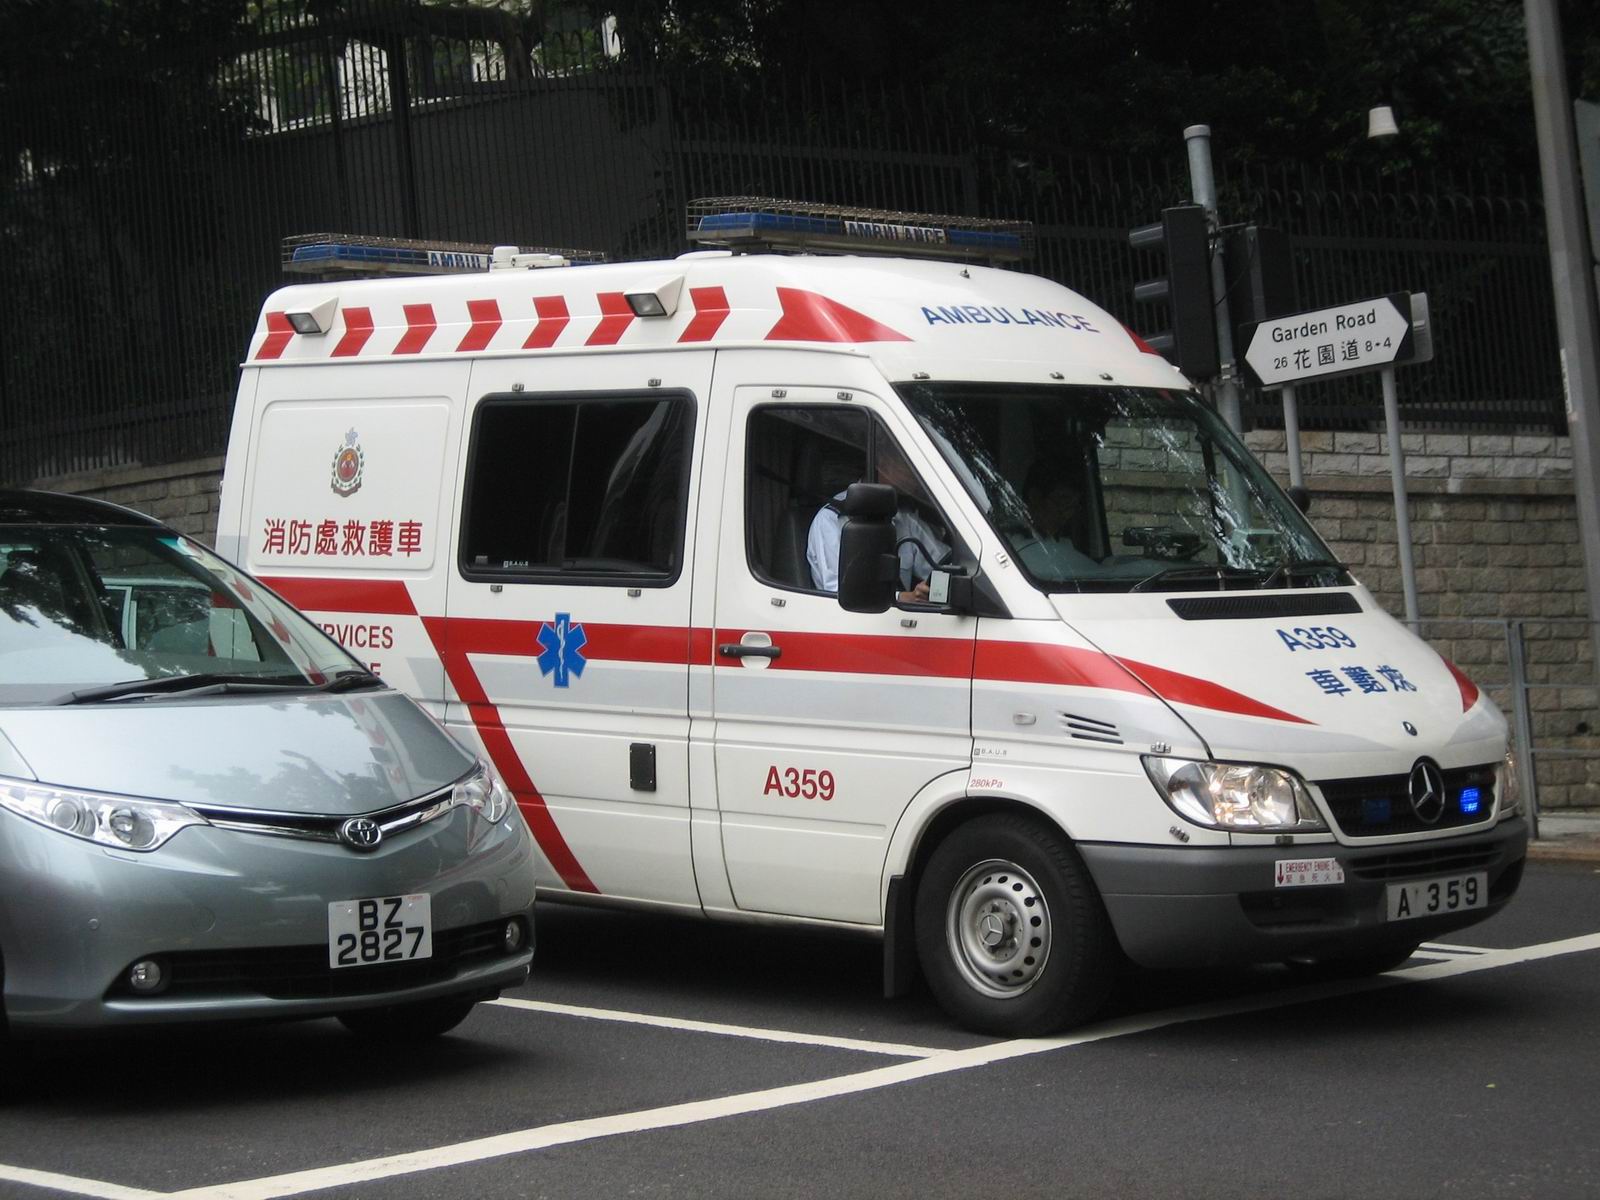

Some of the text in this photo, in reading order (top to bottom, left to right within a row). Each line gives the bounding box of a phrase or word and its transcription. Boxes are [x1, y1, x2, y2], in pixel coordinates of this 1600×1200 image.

[921, 306, 1100, 333] AMBULANCE
[1272, 309, 1376, 343] Garden Road
[1274, 356, 1288, 370] 26
[1293, 339, 1360, 370] 花園道
[262, 518, 423, 557] 消防處救護車
[1276, 626, 1357, 652] A359
[763, 765, 835, 801] A359
[970, 779, 1003, 788] 280kPa
[359, 897, 403, 932] BZ
[1398, 877, 1478, 918] A 359
[337, 926, 424, 966] 2827
